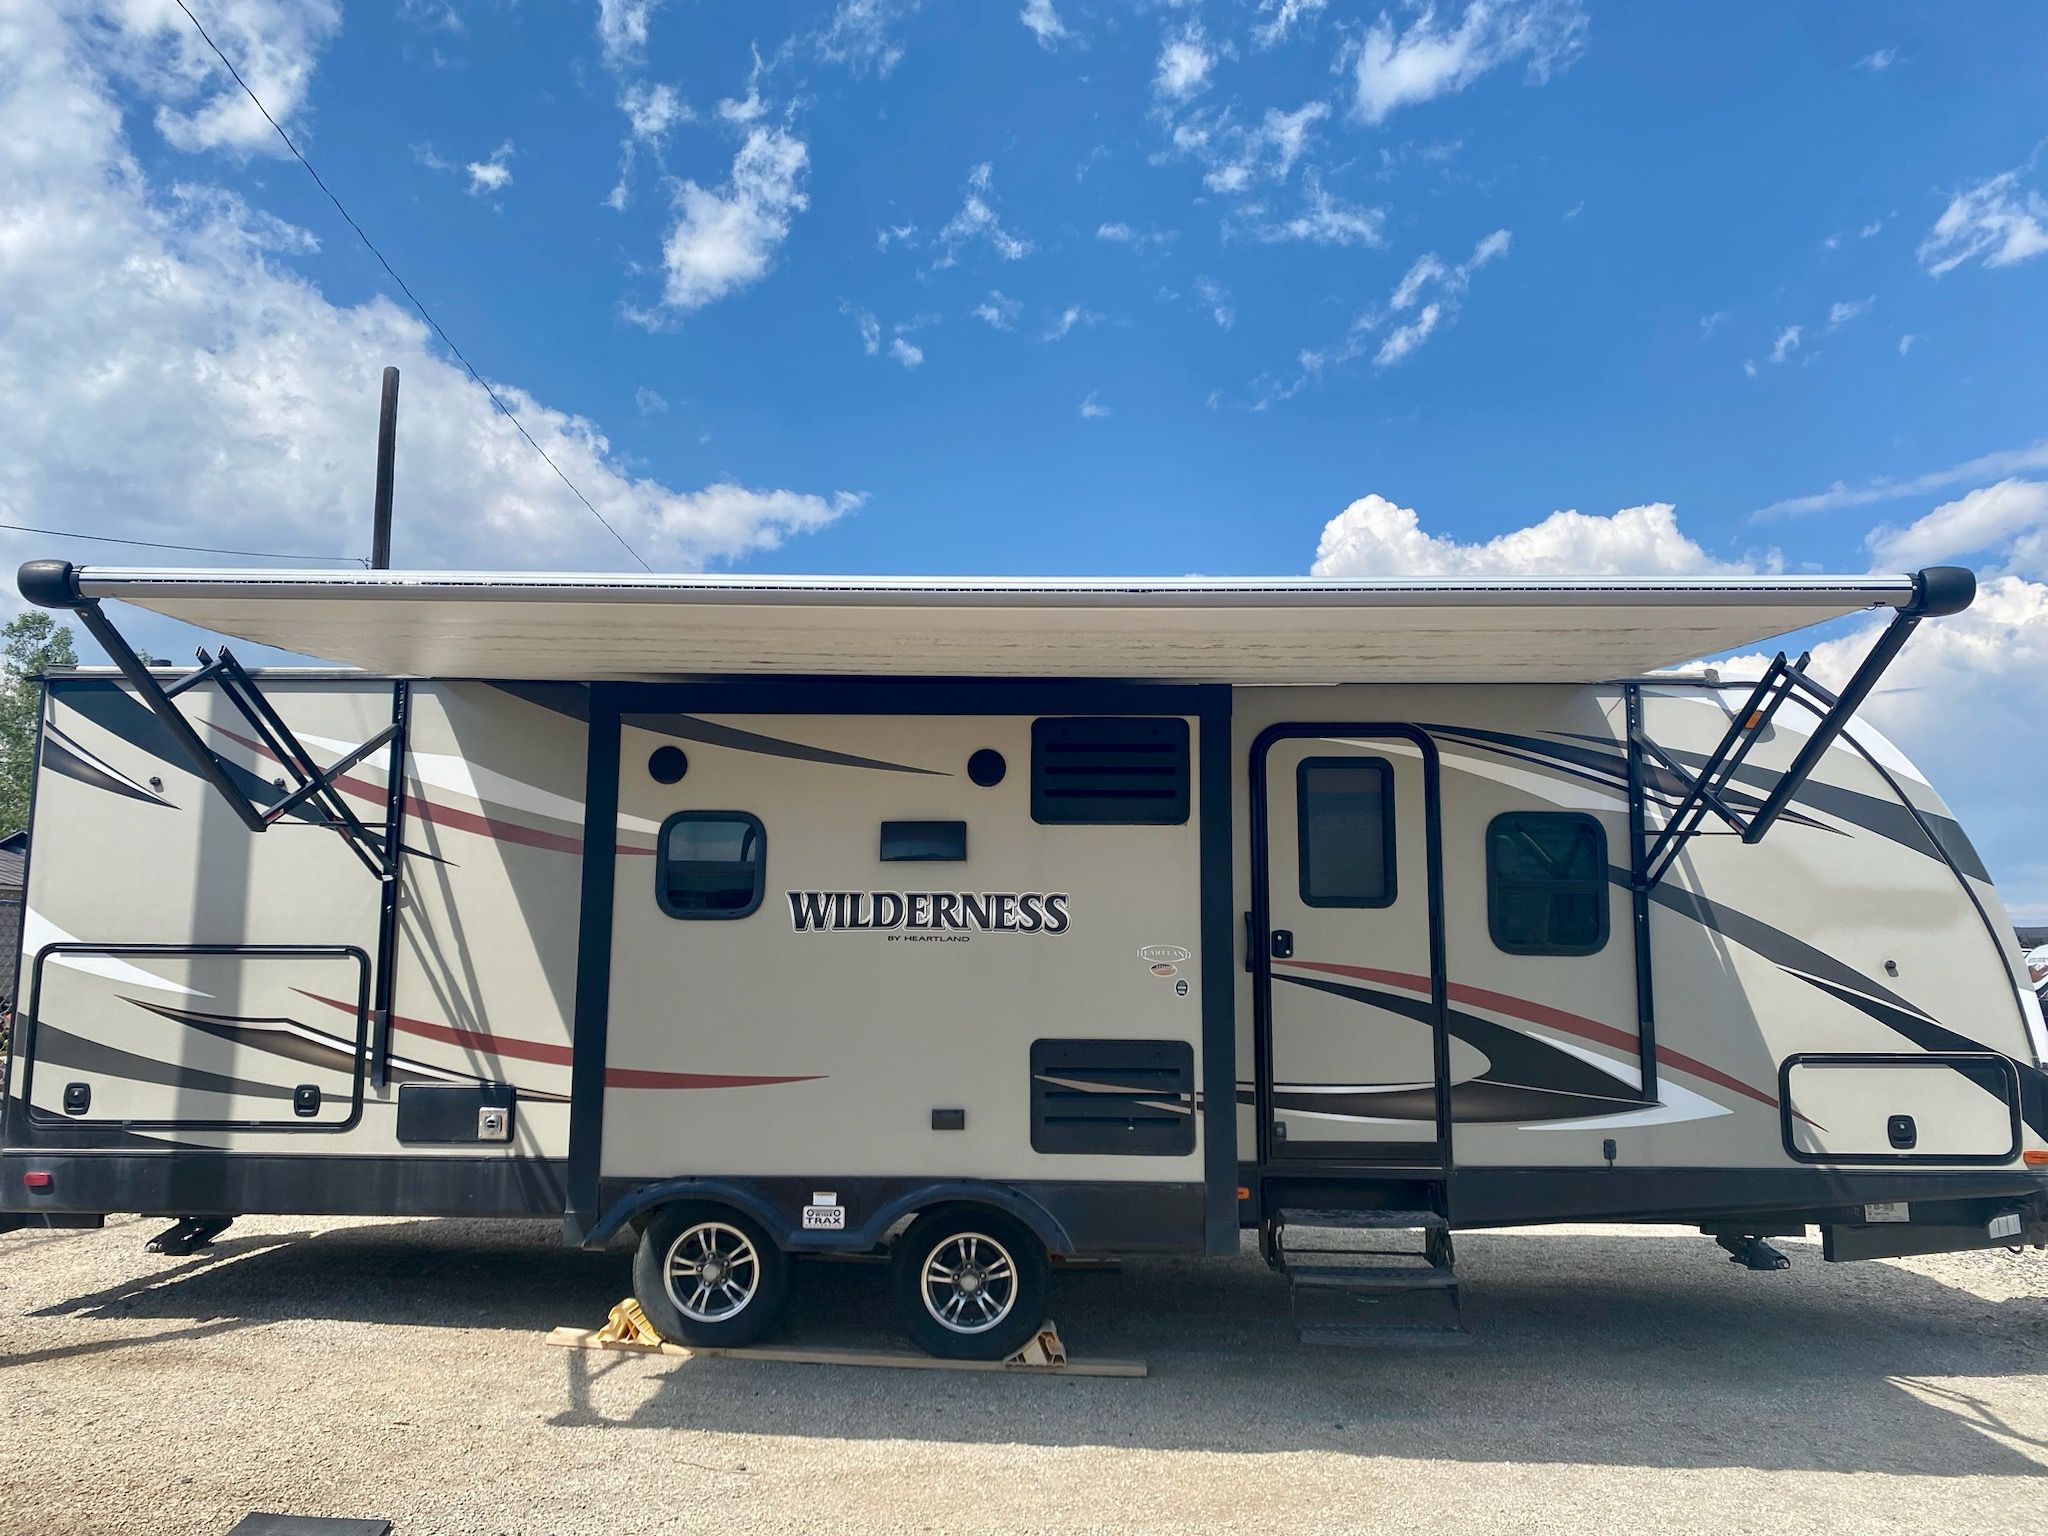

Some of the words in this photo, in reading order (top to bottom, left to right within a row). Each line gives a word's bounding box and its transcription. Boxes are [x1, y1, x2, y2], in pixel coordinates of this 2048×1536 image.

[785, 890, 1072, 936] WILDERNESS
[904, 935, 970, 943] HEARTLAND
[1136, 949, 1191, 959] HEARTLAND
